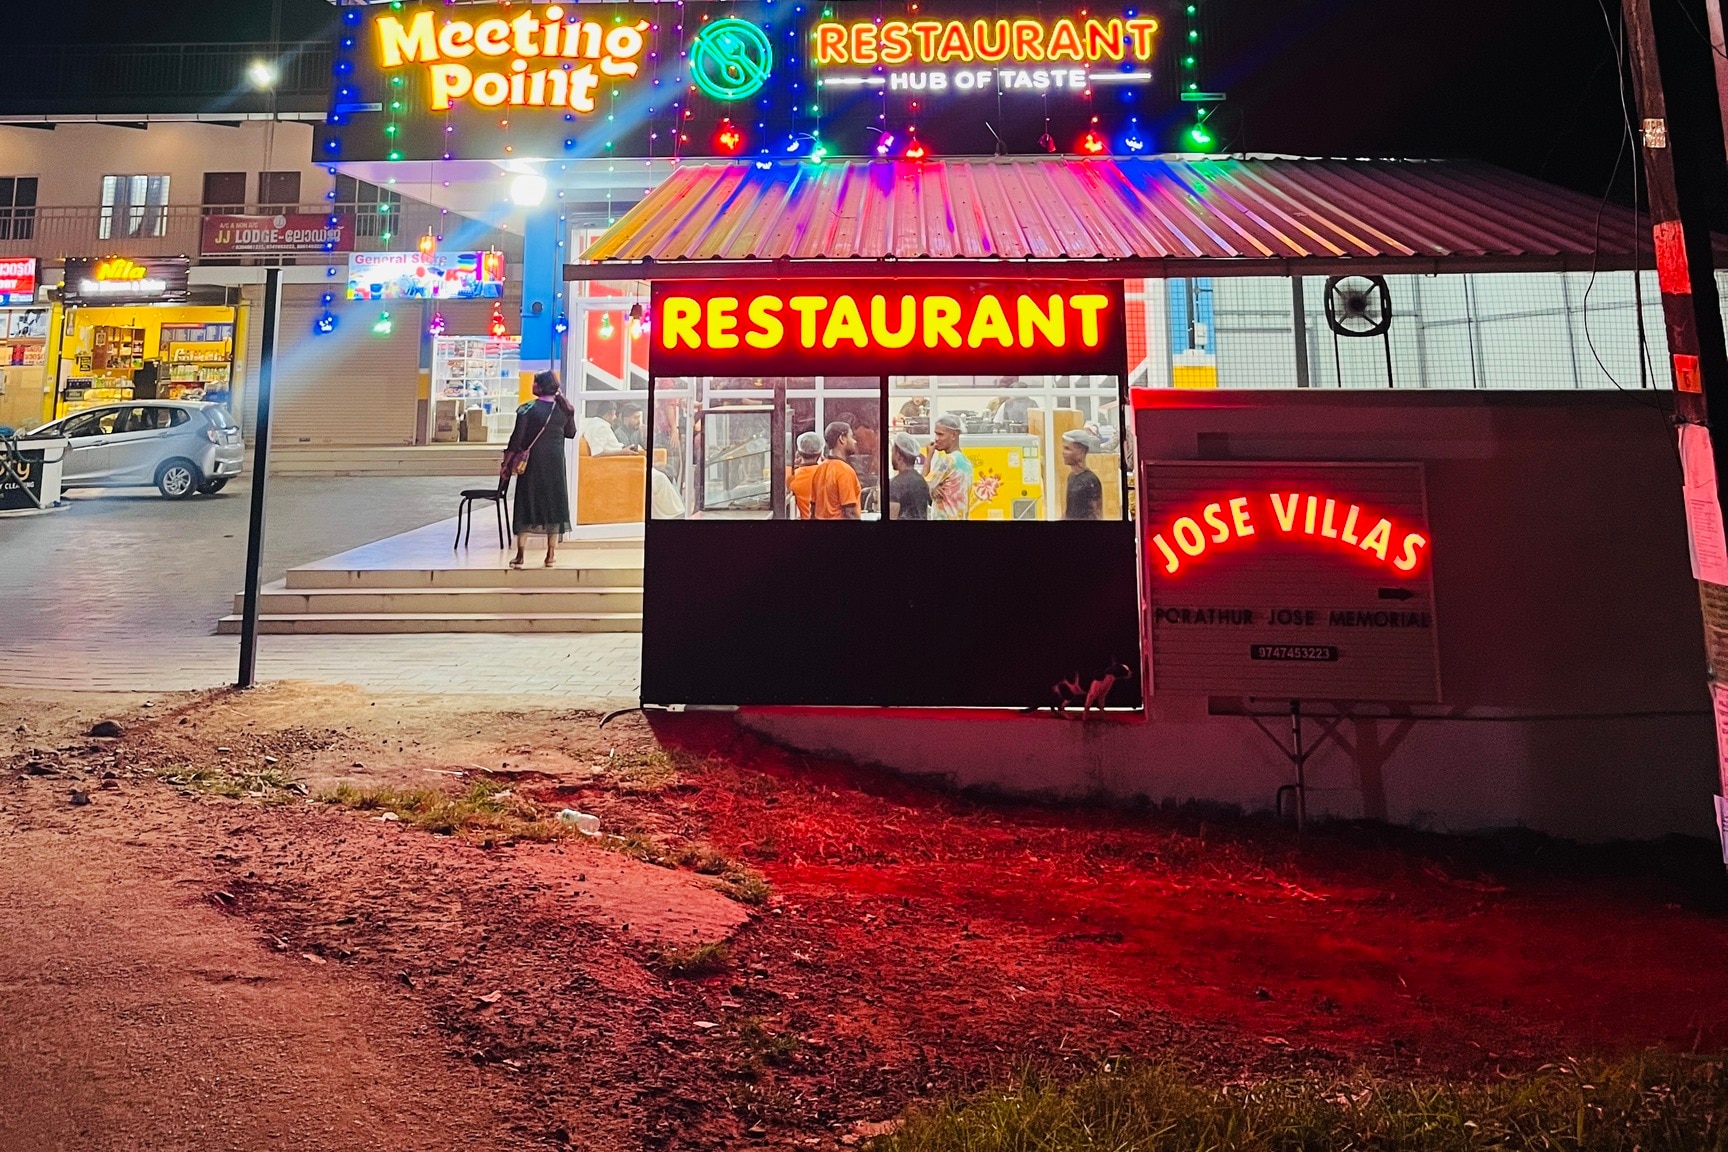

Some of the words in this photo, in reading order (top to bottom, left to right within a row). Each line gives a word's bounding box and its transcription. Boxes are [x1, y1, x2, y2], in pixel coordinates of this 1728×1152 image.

[376, 7, 651, 76] Meeting
[816, 18, 1161, 64] RESTAURANT
[428, 57, 600, 112] Point
[890, 72, 948, 90] HUB
[954, 71, 993, 89] OF
[999, 69, 1087, 89] TASTE
[215, 230, 231, 244] JJ
[97, 259, 147, 280] Nila
[355, 253, 407, 265] General
[662, 293, 1109, 350] RESTAURANT
[1152, 497, 1256, 574] JOSE
[1269, 493, 1427, 572] VILLAS
[1155, 607, 1254, 626] PORATHUR
[1268, 608, 1315, 626] JOSE
[1329, 610, 1431, 628] MEMORIAL
[1258, 646, 1331, 659] 9747453223
